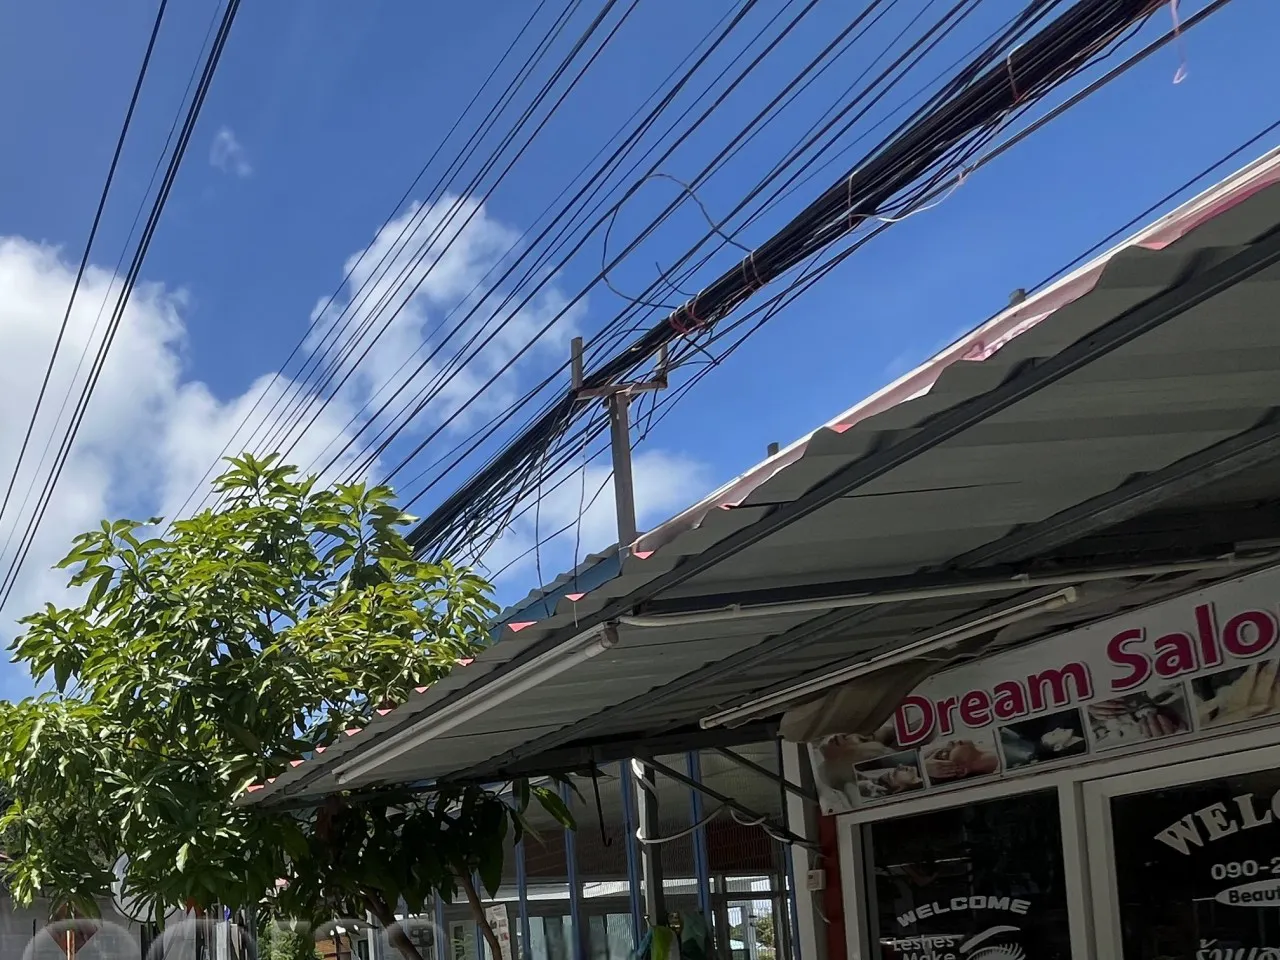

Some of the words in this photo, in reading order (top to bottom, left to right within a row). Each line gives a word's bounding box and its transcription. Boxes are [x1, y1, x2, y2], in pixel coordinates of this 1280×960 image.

[895, 661, 1094, 748] Dream
[1107, 602, 1280, 694] Salo
[896, 896, 1031, 927] WELCOME
